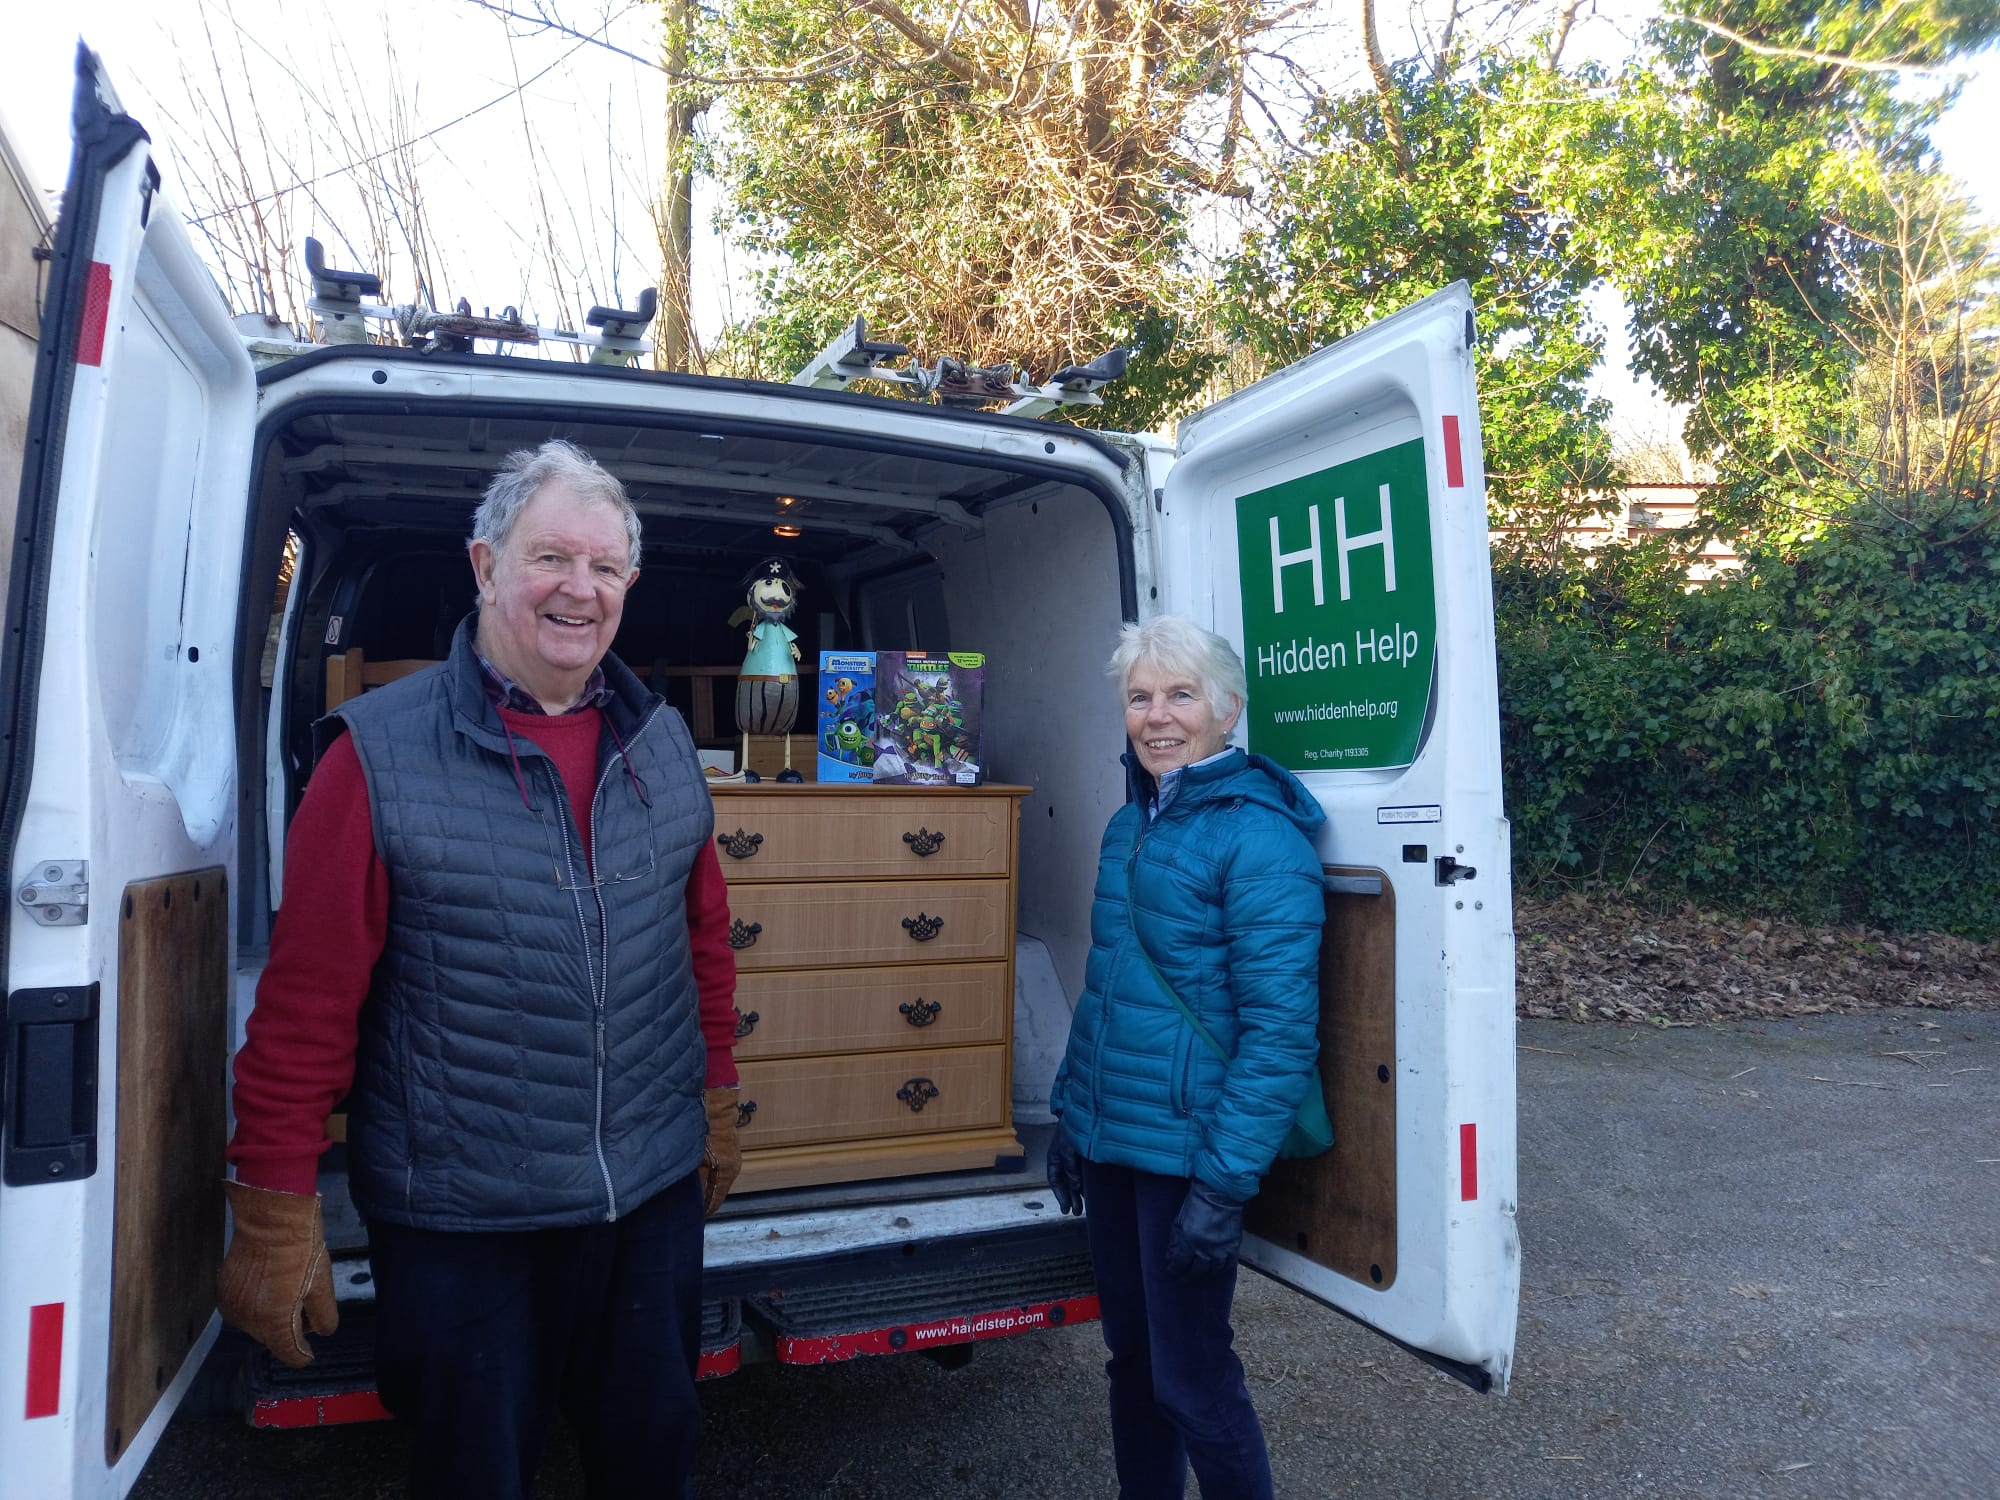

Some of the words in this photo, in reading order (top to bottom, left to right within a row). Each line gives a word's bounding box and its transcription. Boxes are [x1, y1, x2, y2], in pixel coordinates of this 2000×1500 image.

[1269, 483, 1396, 613] HH
[1257, 637, 1346, 677] Hidden
[1356, 622, 1418, 668] Help
[907, 663, 950, 672] TURTLES
[1274, 698, 1398, 723] www.hiddenhelp.org
[1304, 750, 1318, 760] Reg.
[1320, 748, 1344, 760] Charity
[1344, 747, 1369, 757] 1193305
